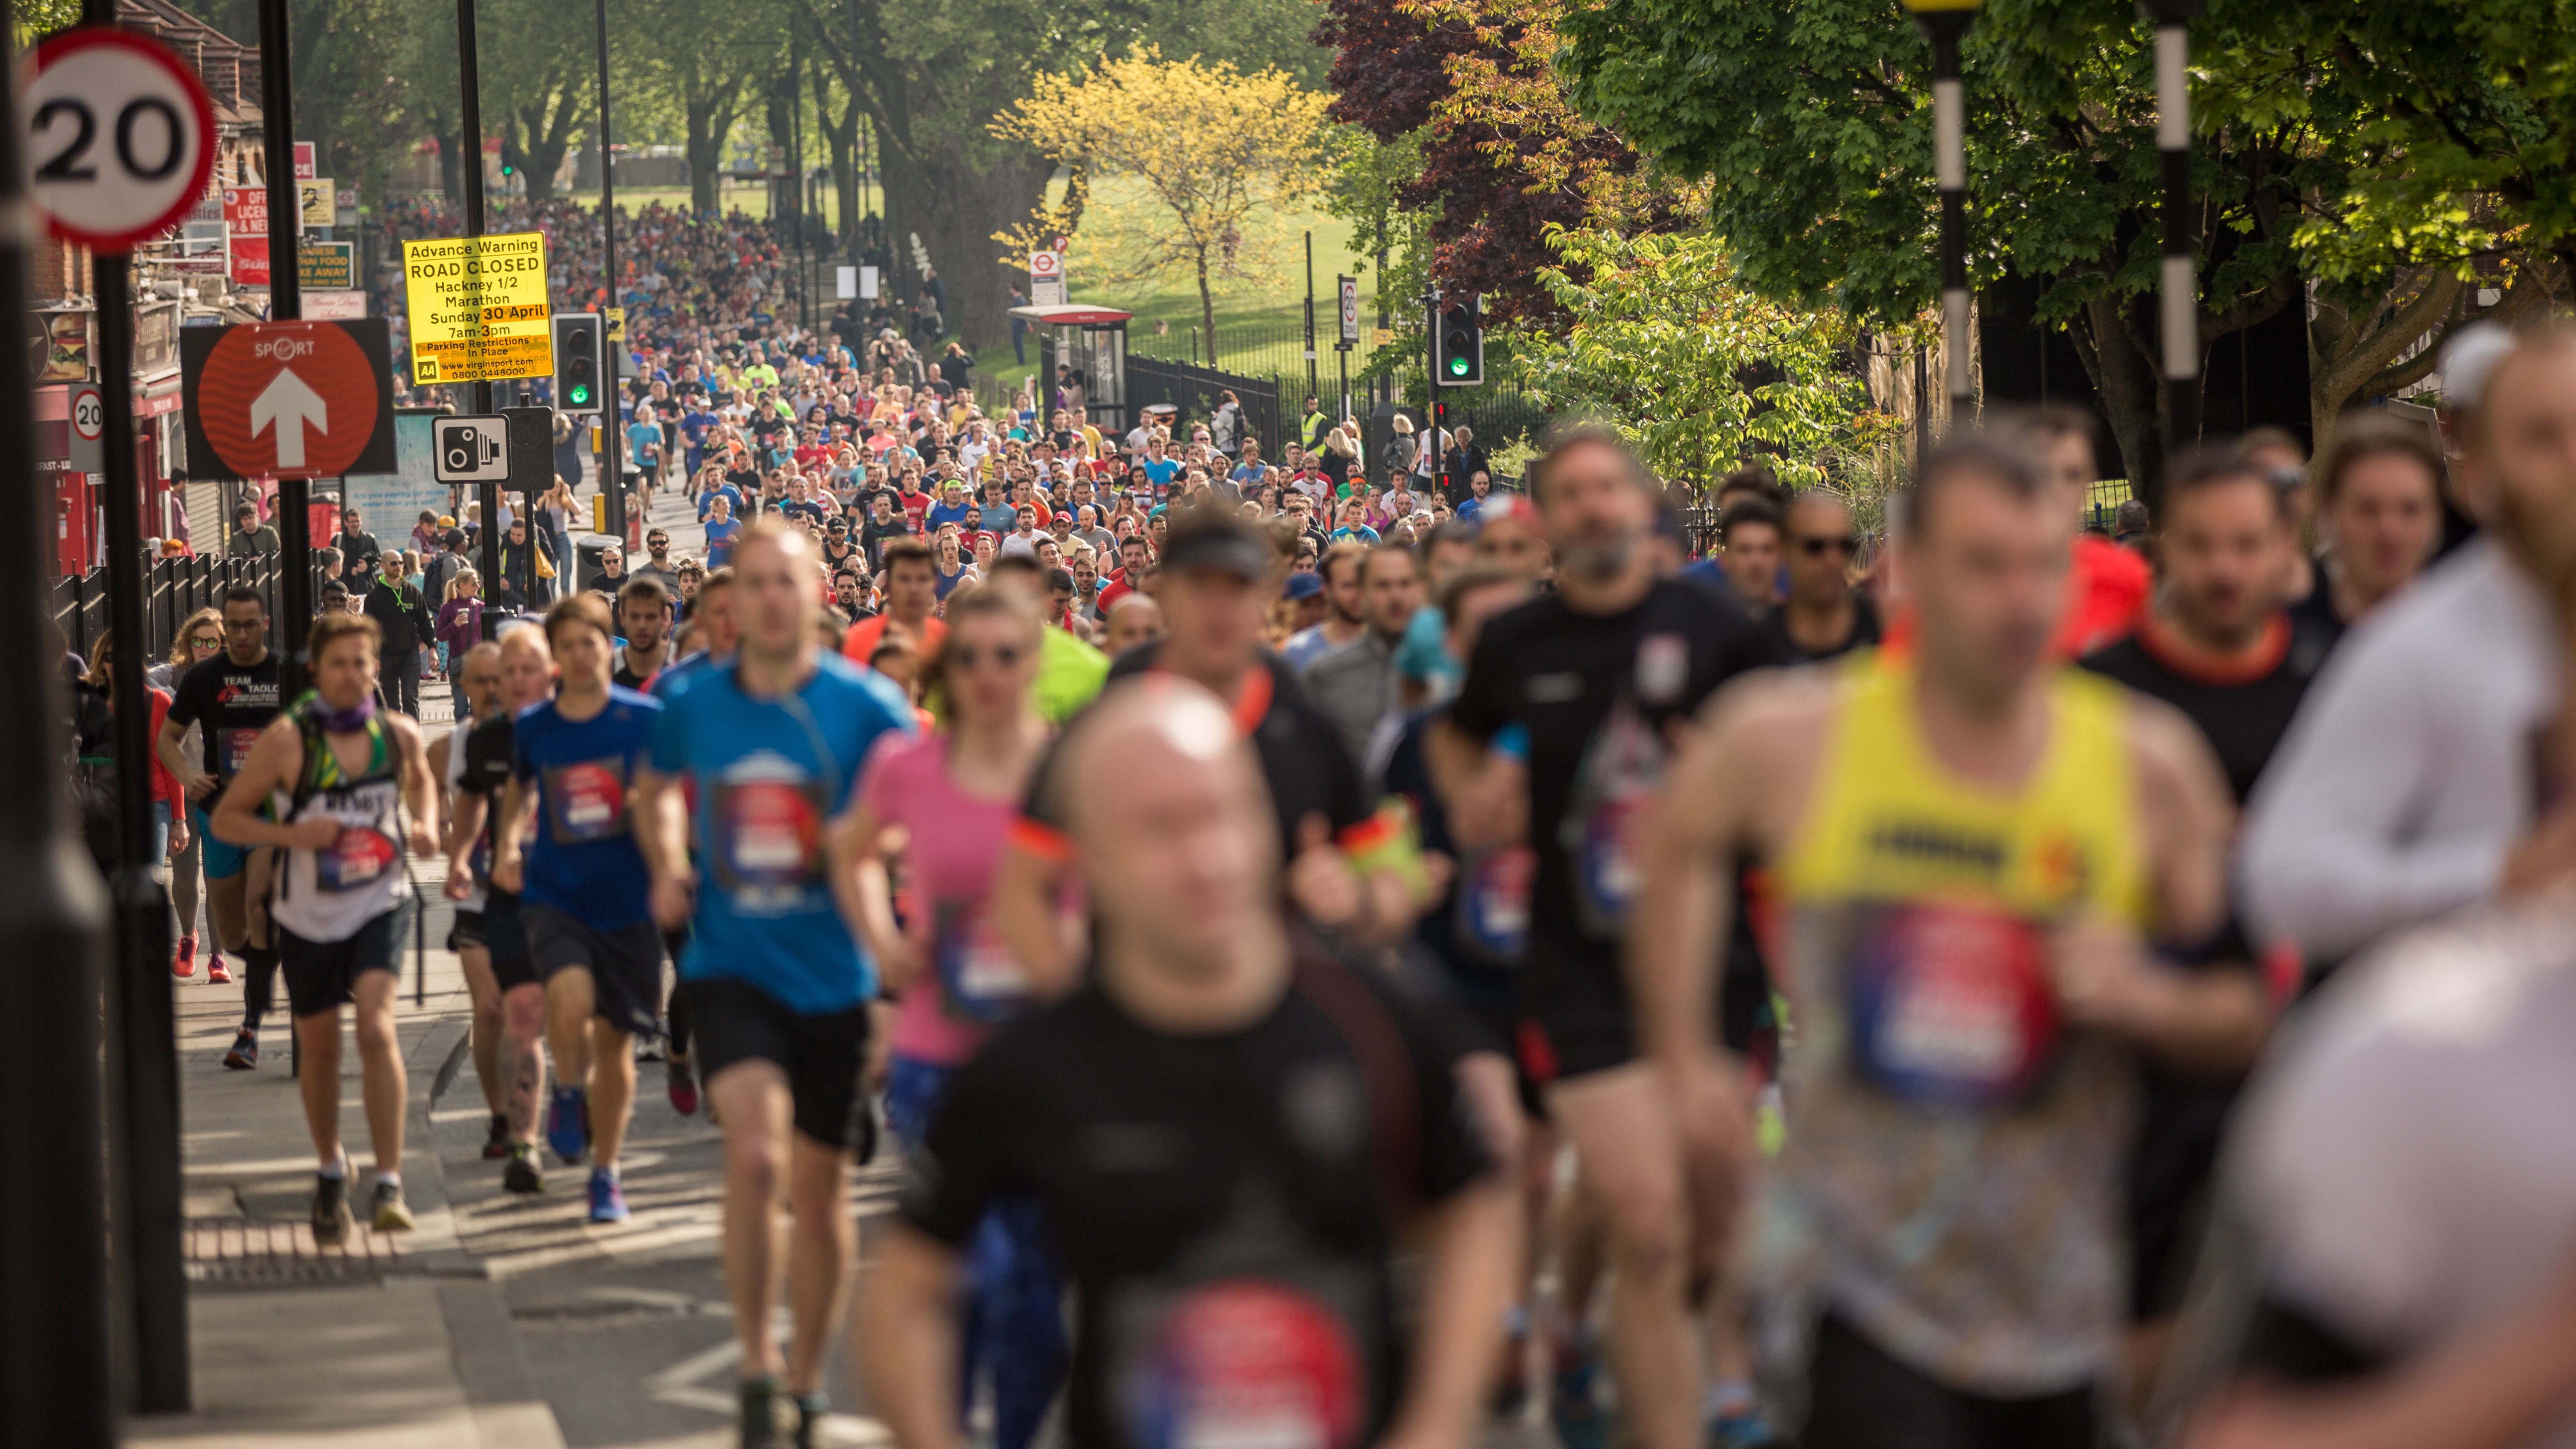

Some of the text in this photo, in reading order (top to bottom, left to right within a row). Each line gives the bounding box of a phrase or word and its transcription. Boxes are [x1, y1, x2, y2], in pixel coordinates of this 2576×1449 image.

[32, 96, 185, 182] 20
[295, 163, 312, 176] CE
[237, 205, 268, 219] LICEN
[240, 219, 269, 233] & NE
[411, 240, 538, 258] Advance Warning
[1056, 238, 1066, 250] P
[320, 256, 348, 266] FOOD
[411, 257, 539, 278] ROAD CLOSED
[299, 267, 348, 277] KE AWAY
[435, 277, 517, 293] Hackney 1/2
[446, 295, 509, 308] Marathon
[431, 305, 544, 324] Sunday 30 April
[448, 325, 510, 339] 7am-3pm
[1345, 324, 1357, 334] ZONE
[255, 338, 315, 361] SPORT
[427, 336, 529, 351] Parking Restrictions
[482, 348, 508, 356] Place
[421, 365, 435, 377] AA
[442, 358, 533, 371] www.virginsport.com
[481, 368, 525, 378] 0448000
[79, 404, 101, 425] 20
[224, 676, 251, 685] TEAM
